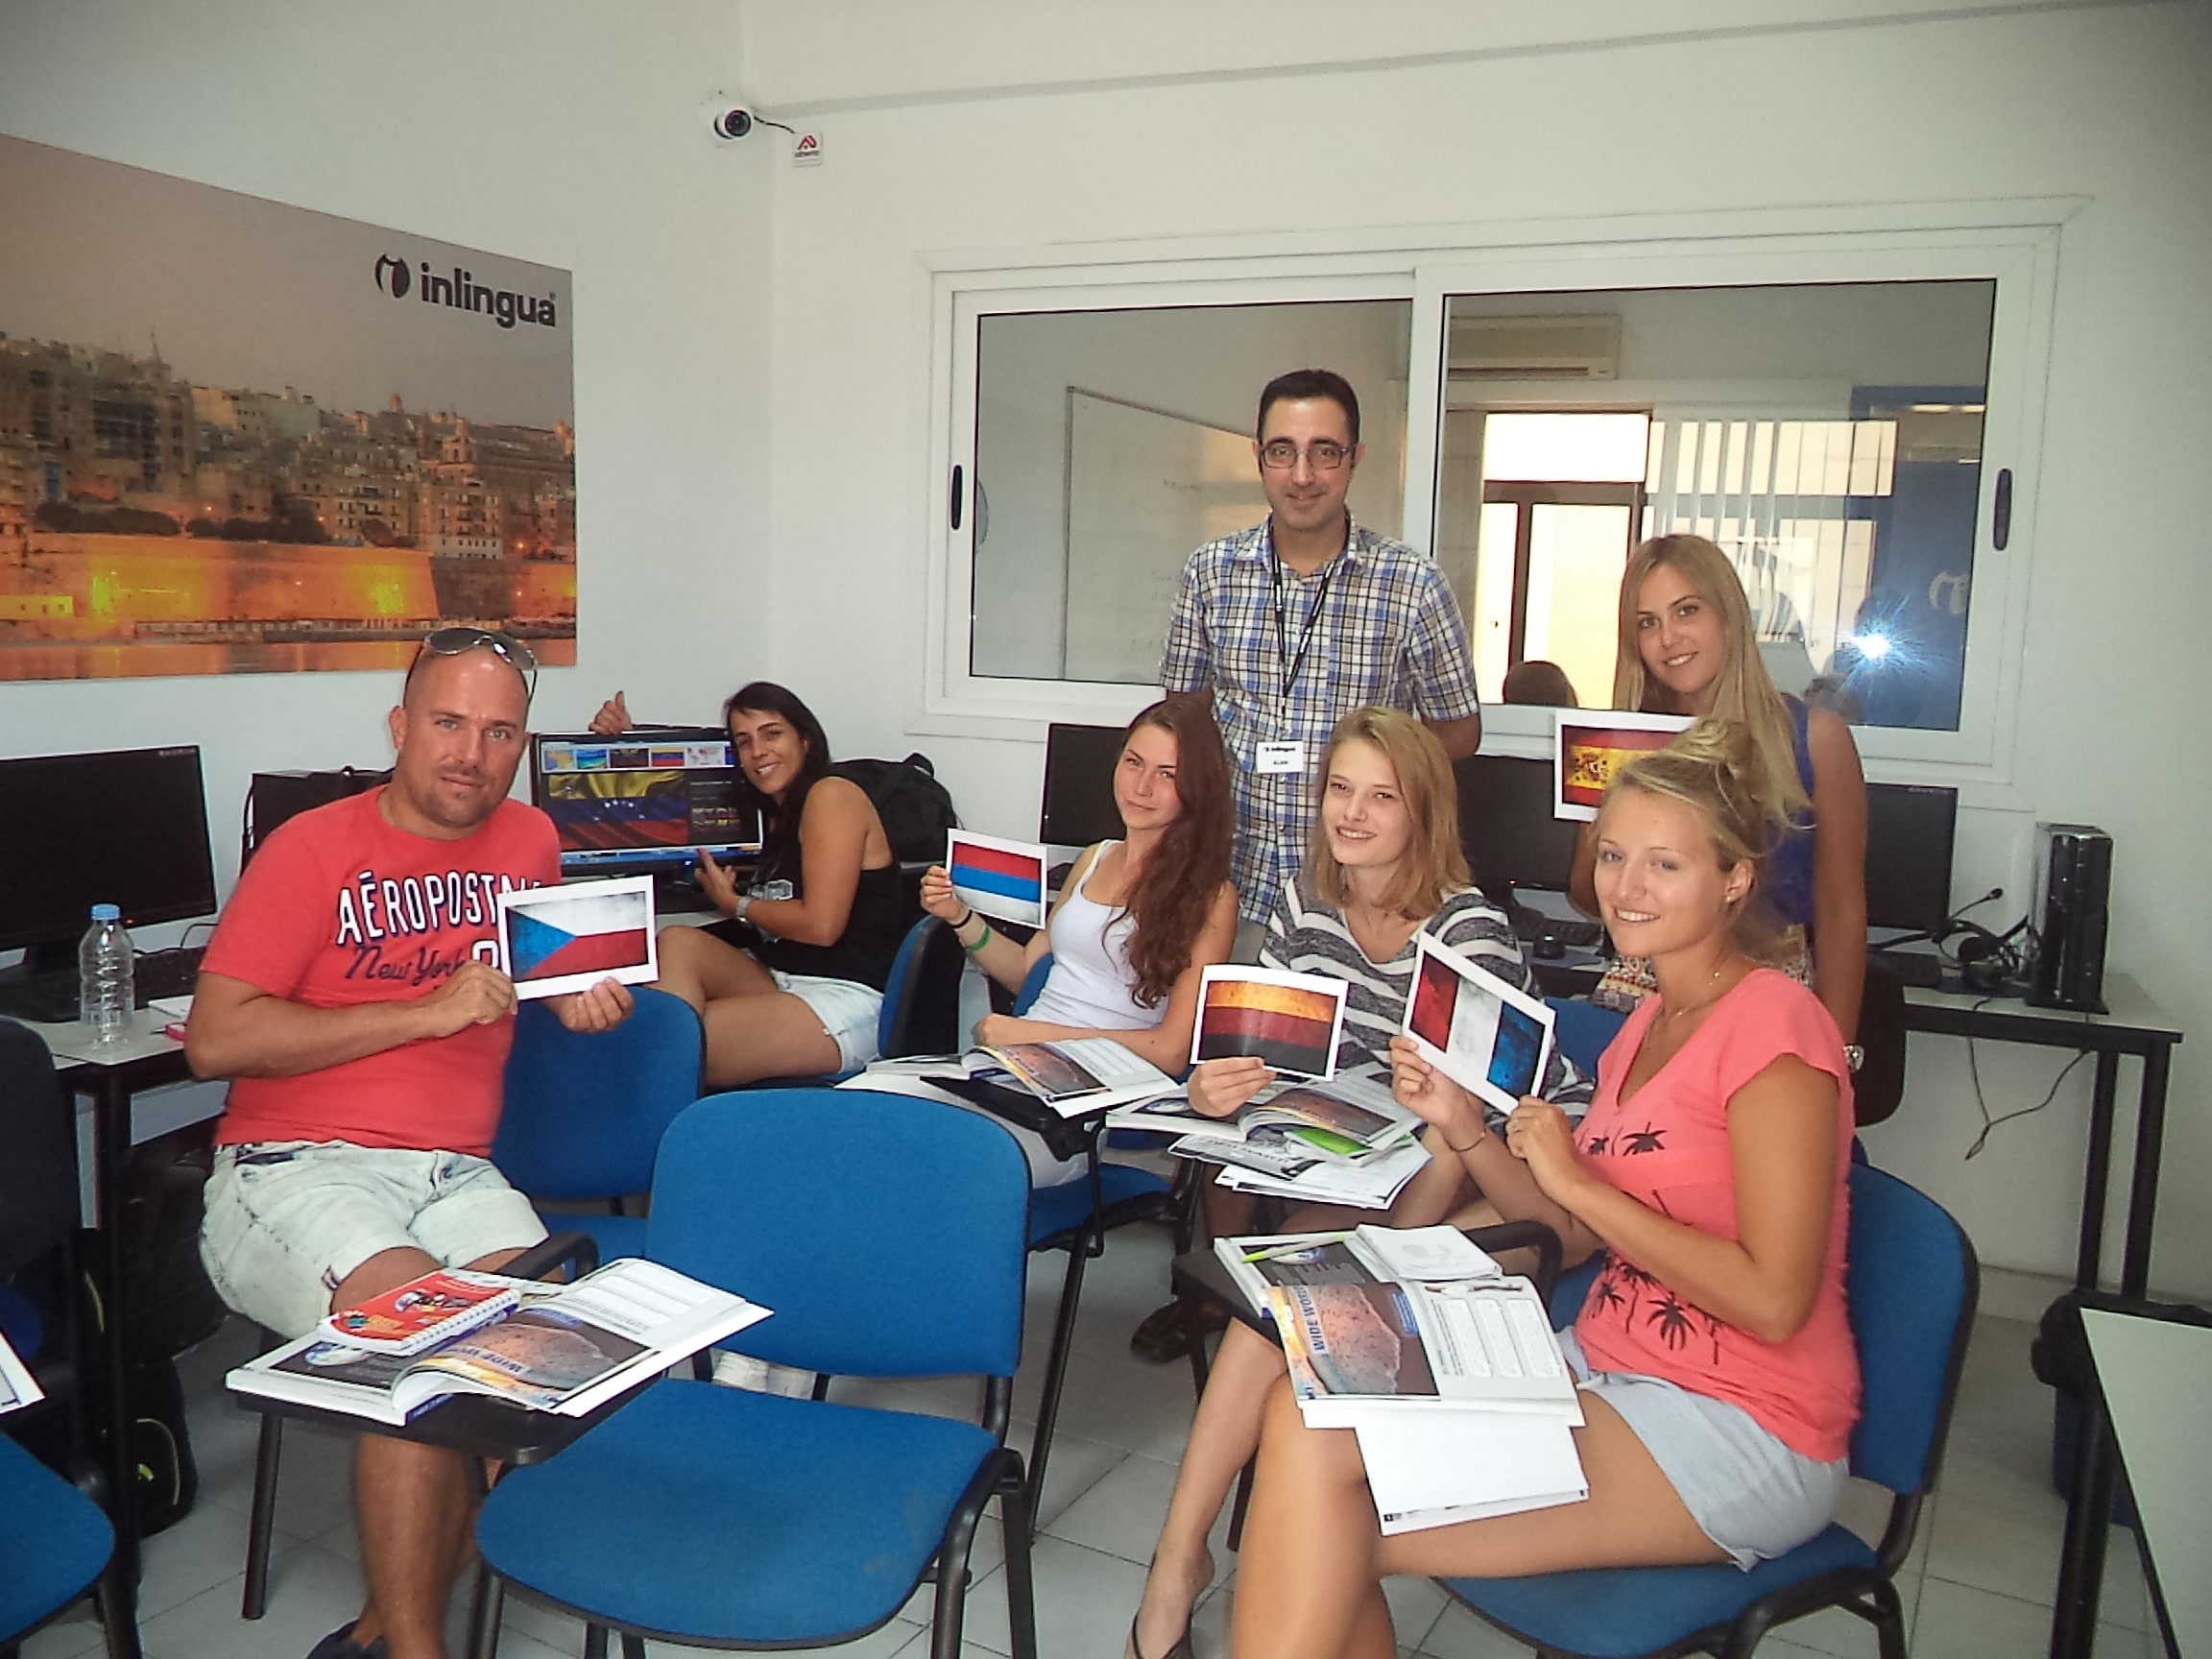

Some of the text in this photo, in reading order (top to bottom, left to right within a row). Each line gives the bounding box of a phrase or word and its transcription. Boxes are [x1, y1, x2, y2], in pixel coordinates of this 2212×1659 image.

[421, 261, 557, 329] inlingua
[336, 870, 541, 946] AÉROPOST
[345, 943, 413, 980] New
